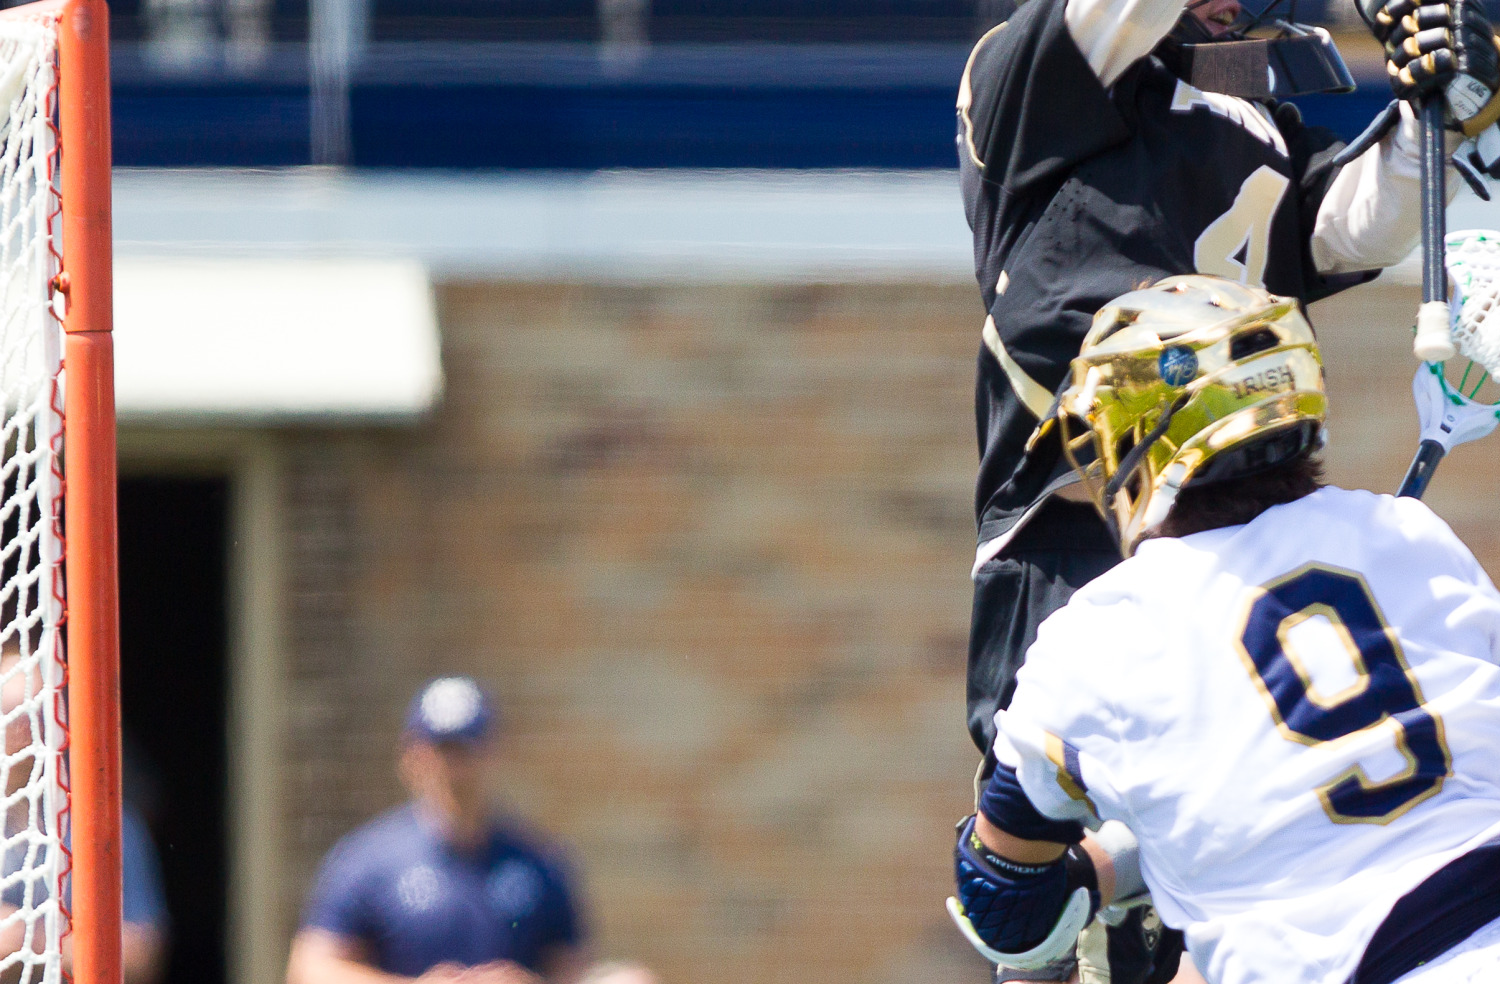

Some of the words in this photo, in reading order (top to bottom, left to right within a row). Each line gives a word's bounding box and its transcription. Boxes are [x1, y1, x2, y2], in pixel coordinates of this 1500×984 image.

[1193, 164, 1290, 287] 4
[1233, 365, 1297, 400] IRISH
[1232, 560, 1455, 827] 9
